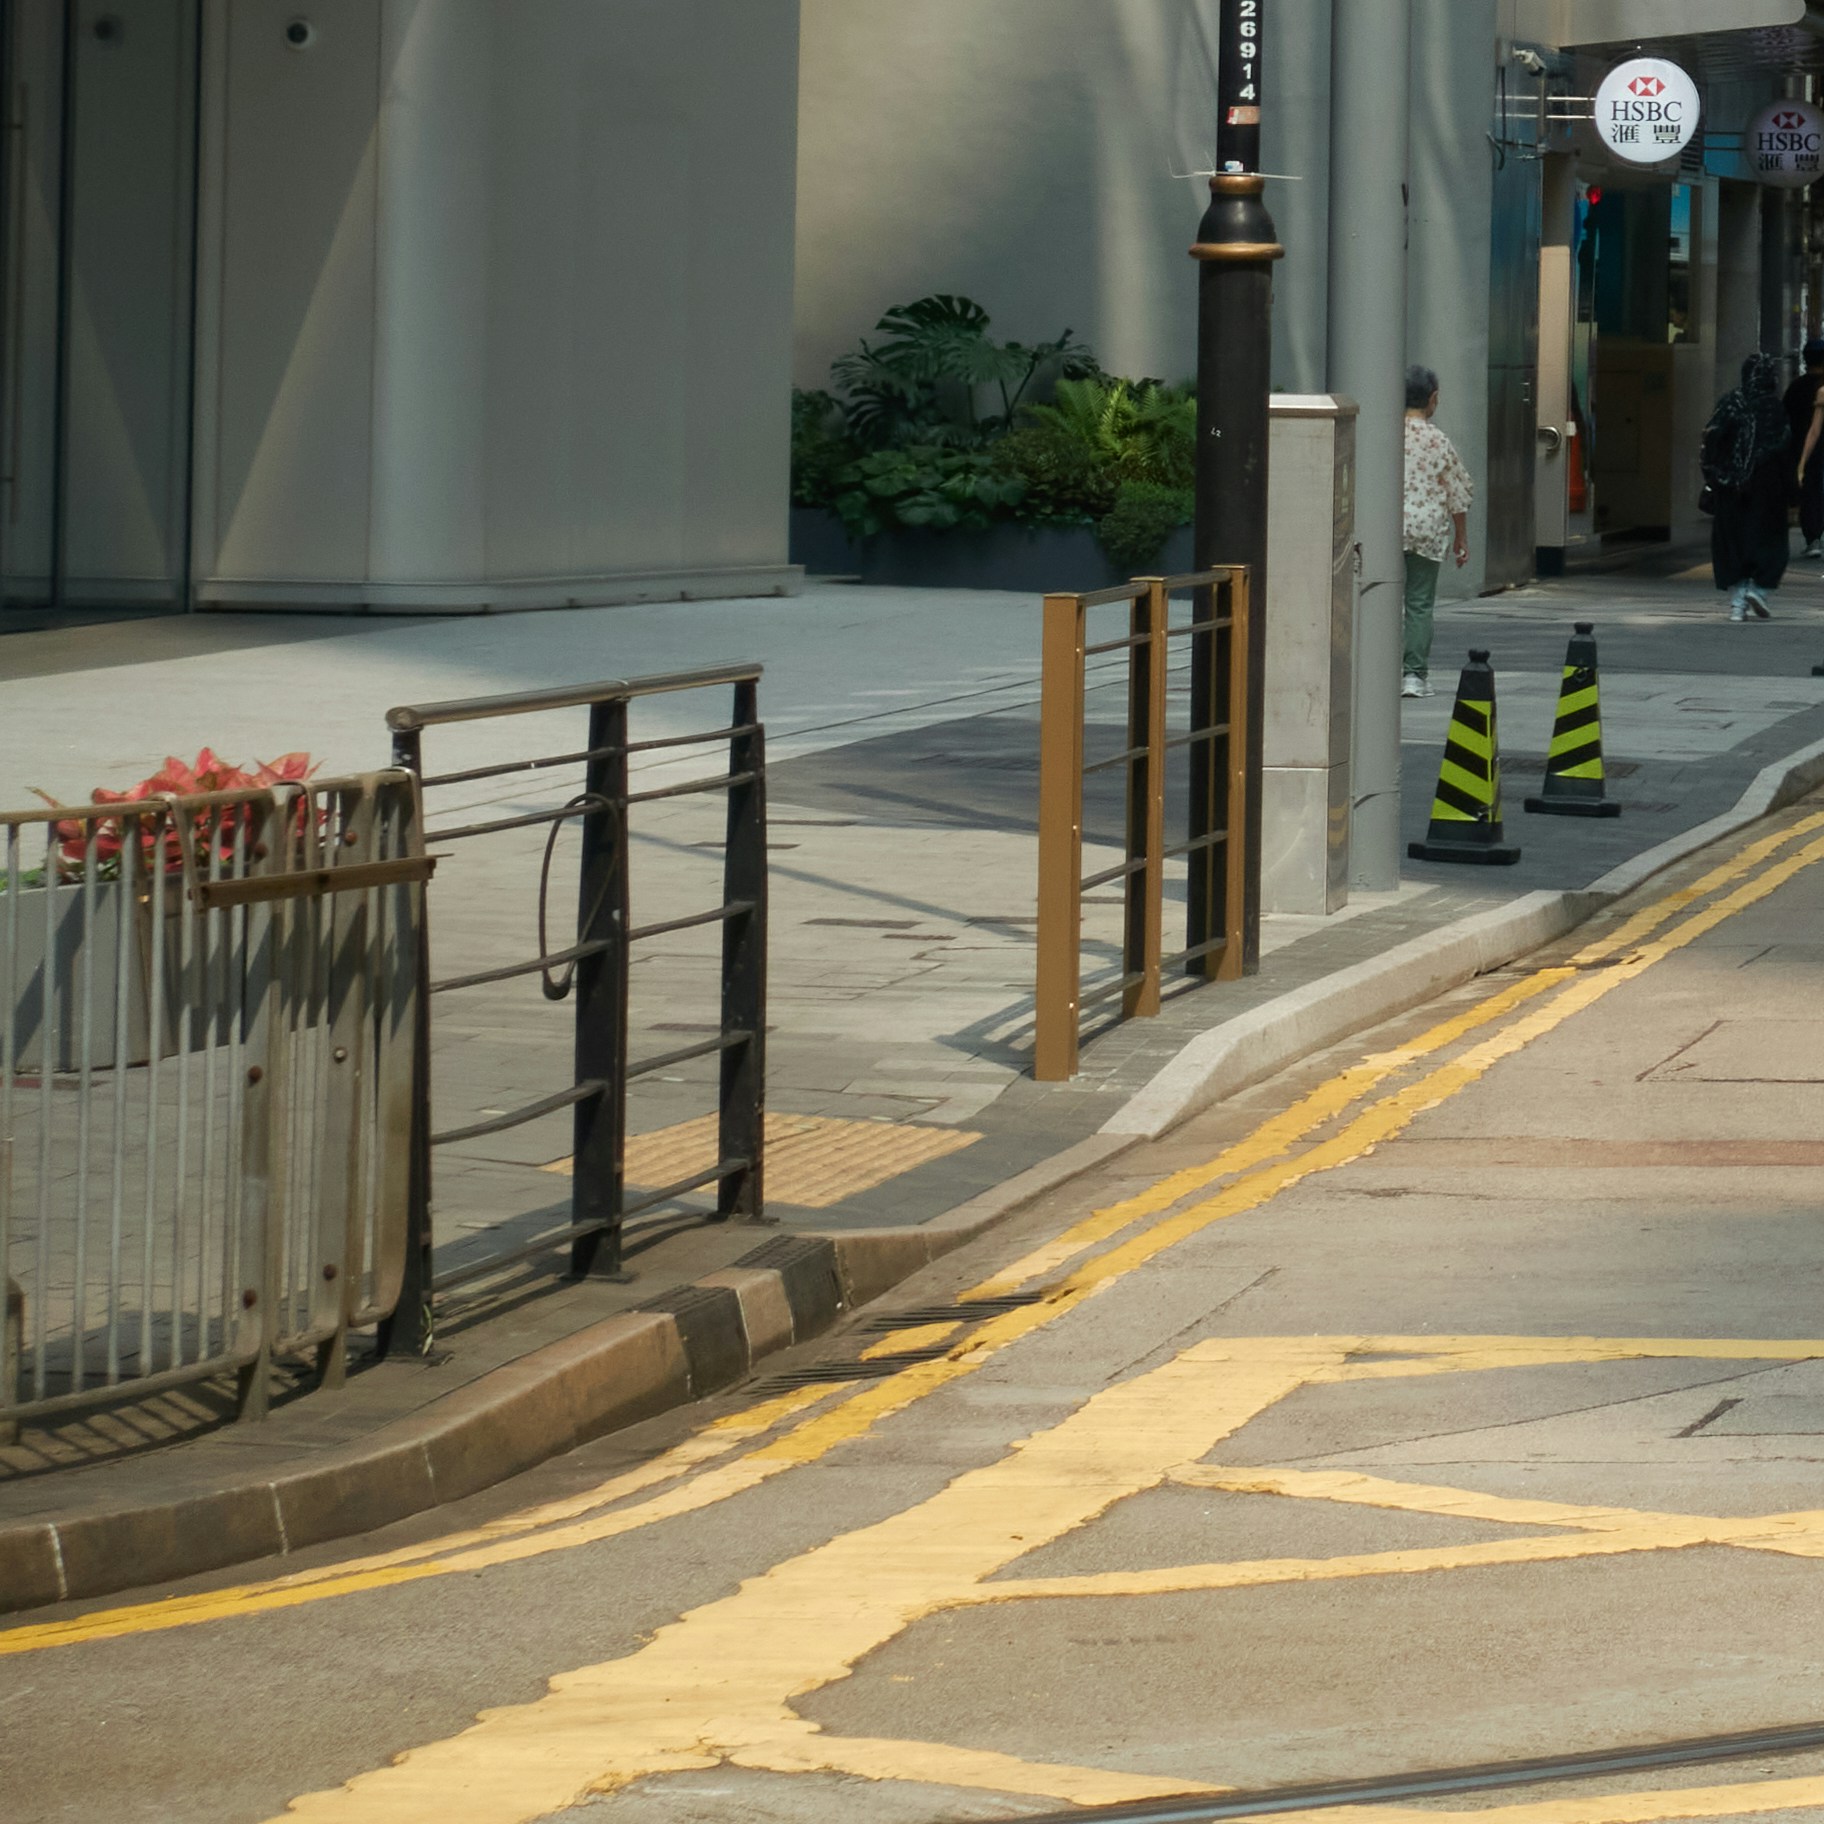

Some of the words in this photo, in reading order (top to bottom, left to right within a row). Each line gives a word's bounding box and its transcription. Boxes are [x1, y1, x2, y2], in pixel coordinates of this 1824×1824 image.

[1239, 0, 1256, 100] 26914
[1610, 100, 1682, 122] HSBC
[1758, 132, 1821, 152] HSBC
